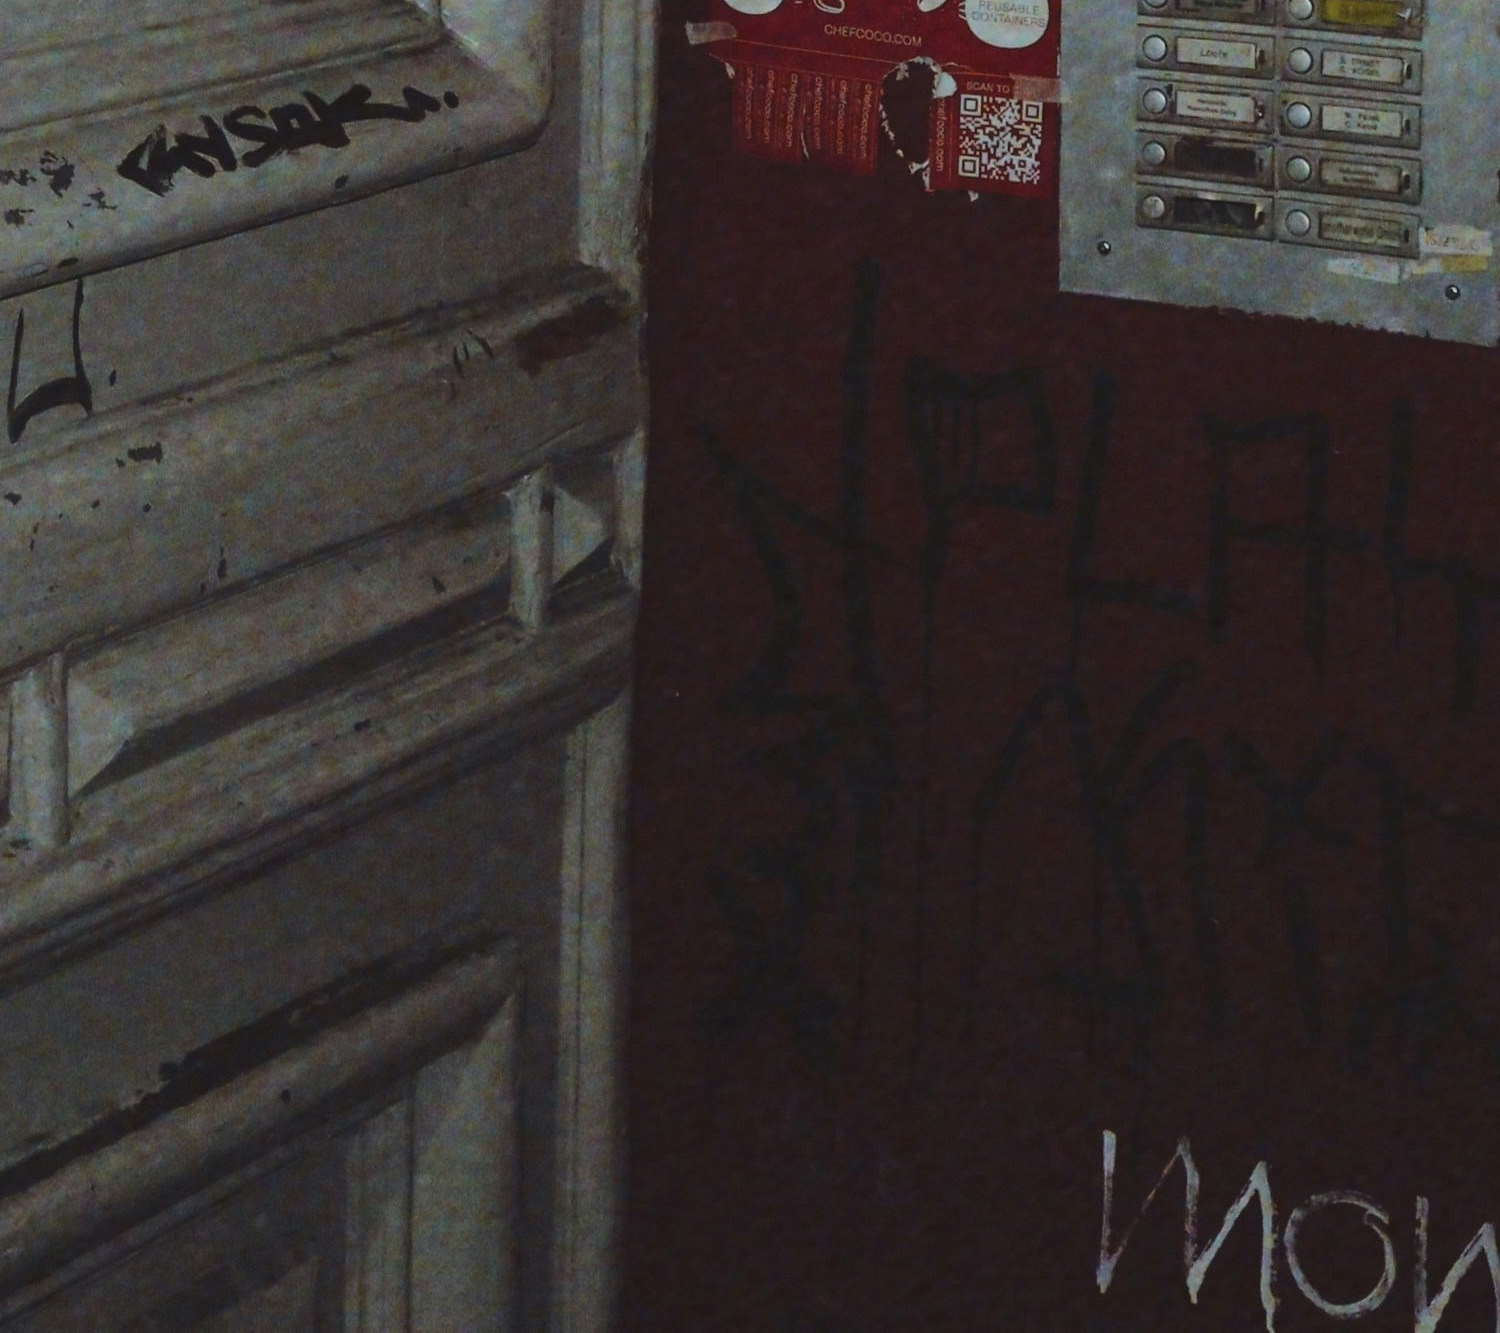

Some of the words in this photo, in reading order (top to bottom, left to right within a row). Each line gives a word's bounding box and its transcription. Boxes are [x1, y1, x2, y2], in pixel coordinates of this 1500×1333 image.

[978, 0, 1040, 16] REUSABLE
[971, 10, 1046, 28] CONTAINERS
[824, 24, 923, 47] CHEFCOCO.COM
[965, 81, 994, 93] SCAN
[996, 83, 1010, 94] TO
